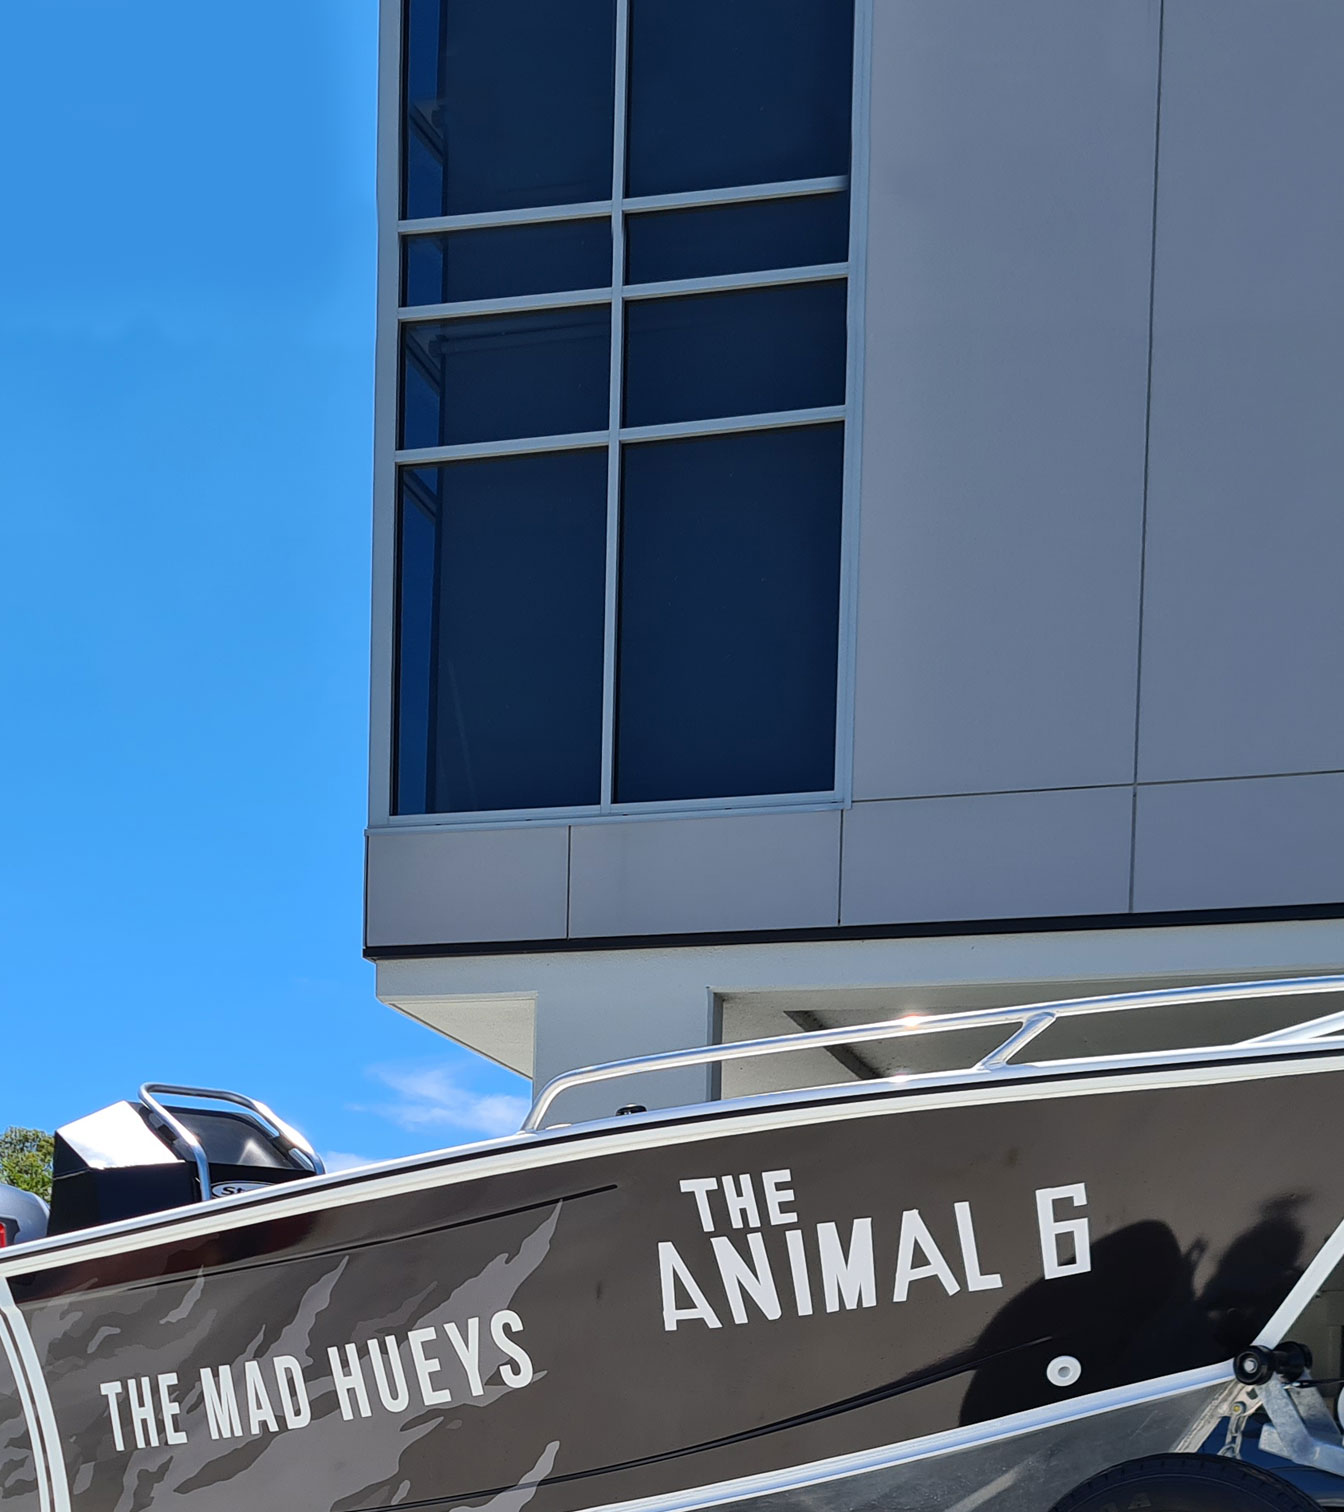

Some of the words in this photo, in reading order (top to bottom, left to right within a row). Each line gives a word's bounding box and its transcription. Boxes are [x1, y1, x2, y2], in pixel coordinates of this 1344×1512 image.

[658, 1201, 1003, 1331] ANIMAL
[1036, 1182, 1092, 1280] 6
[679, 1169, 798, 1232] THE
[100, 1372, 188, 1451] THE
[200, 1355, 311, 1441] MAD
[328, 1309, 534, 1421] HUEYS
